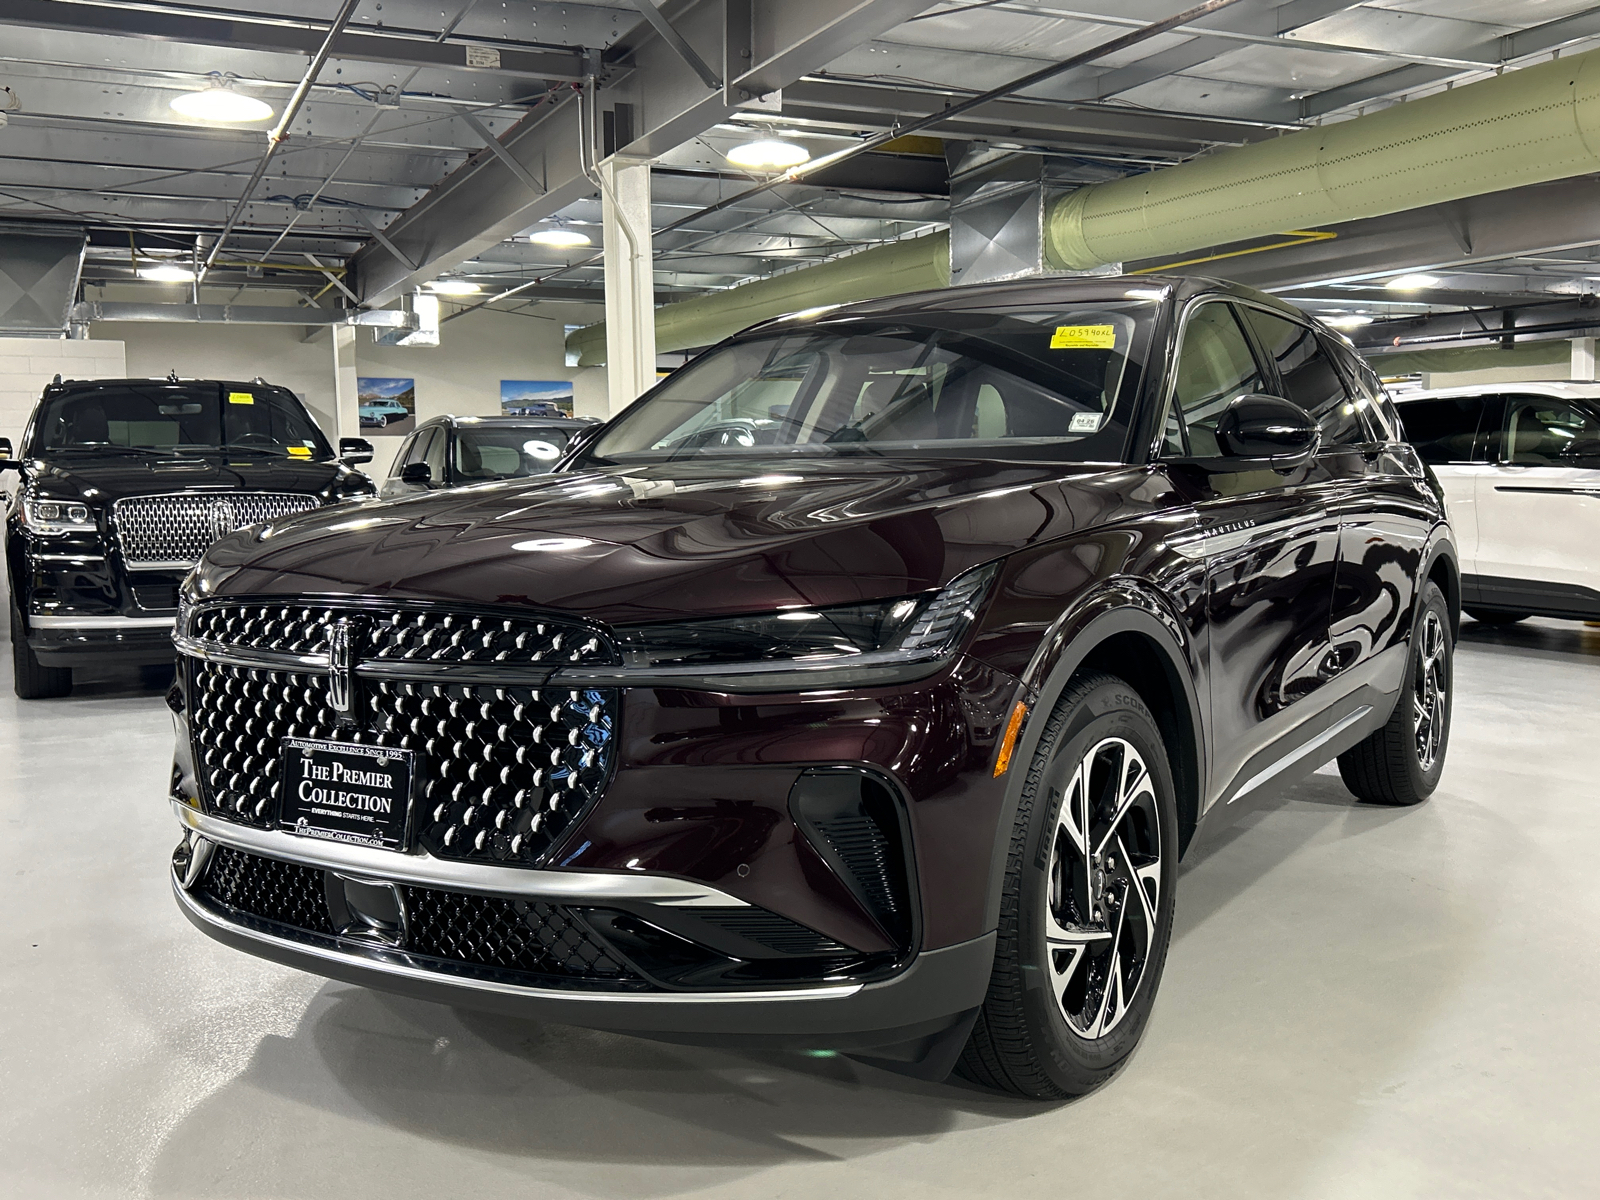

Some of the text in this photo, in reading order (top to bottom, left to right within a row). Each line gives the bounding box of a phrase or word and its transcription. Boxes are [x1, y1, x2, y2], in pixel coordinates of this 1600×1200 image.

[1203, 519, 1256, 538] NAUTILUS
[289, 739, 327, 750] AUTOMOTIVE
[328, 743, 364, 754] EXCELLENCE
[365, 747, 384, 756] SINCE
[299, 757, 393, 790] THE PREMIER
[298, 780, 393, 814] COLLECTION
[311, 807, 342, 818] EVERYTHING
[342, 811, 361, 821] STARTS
